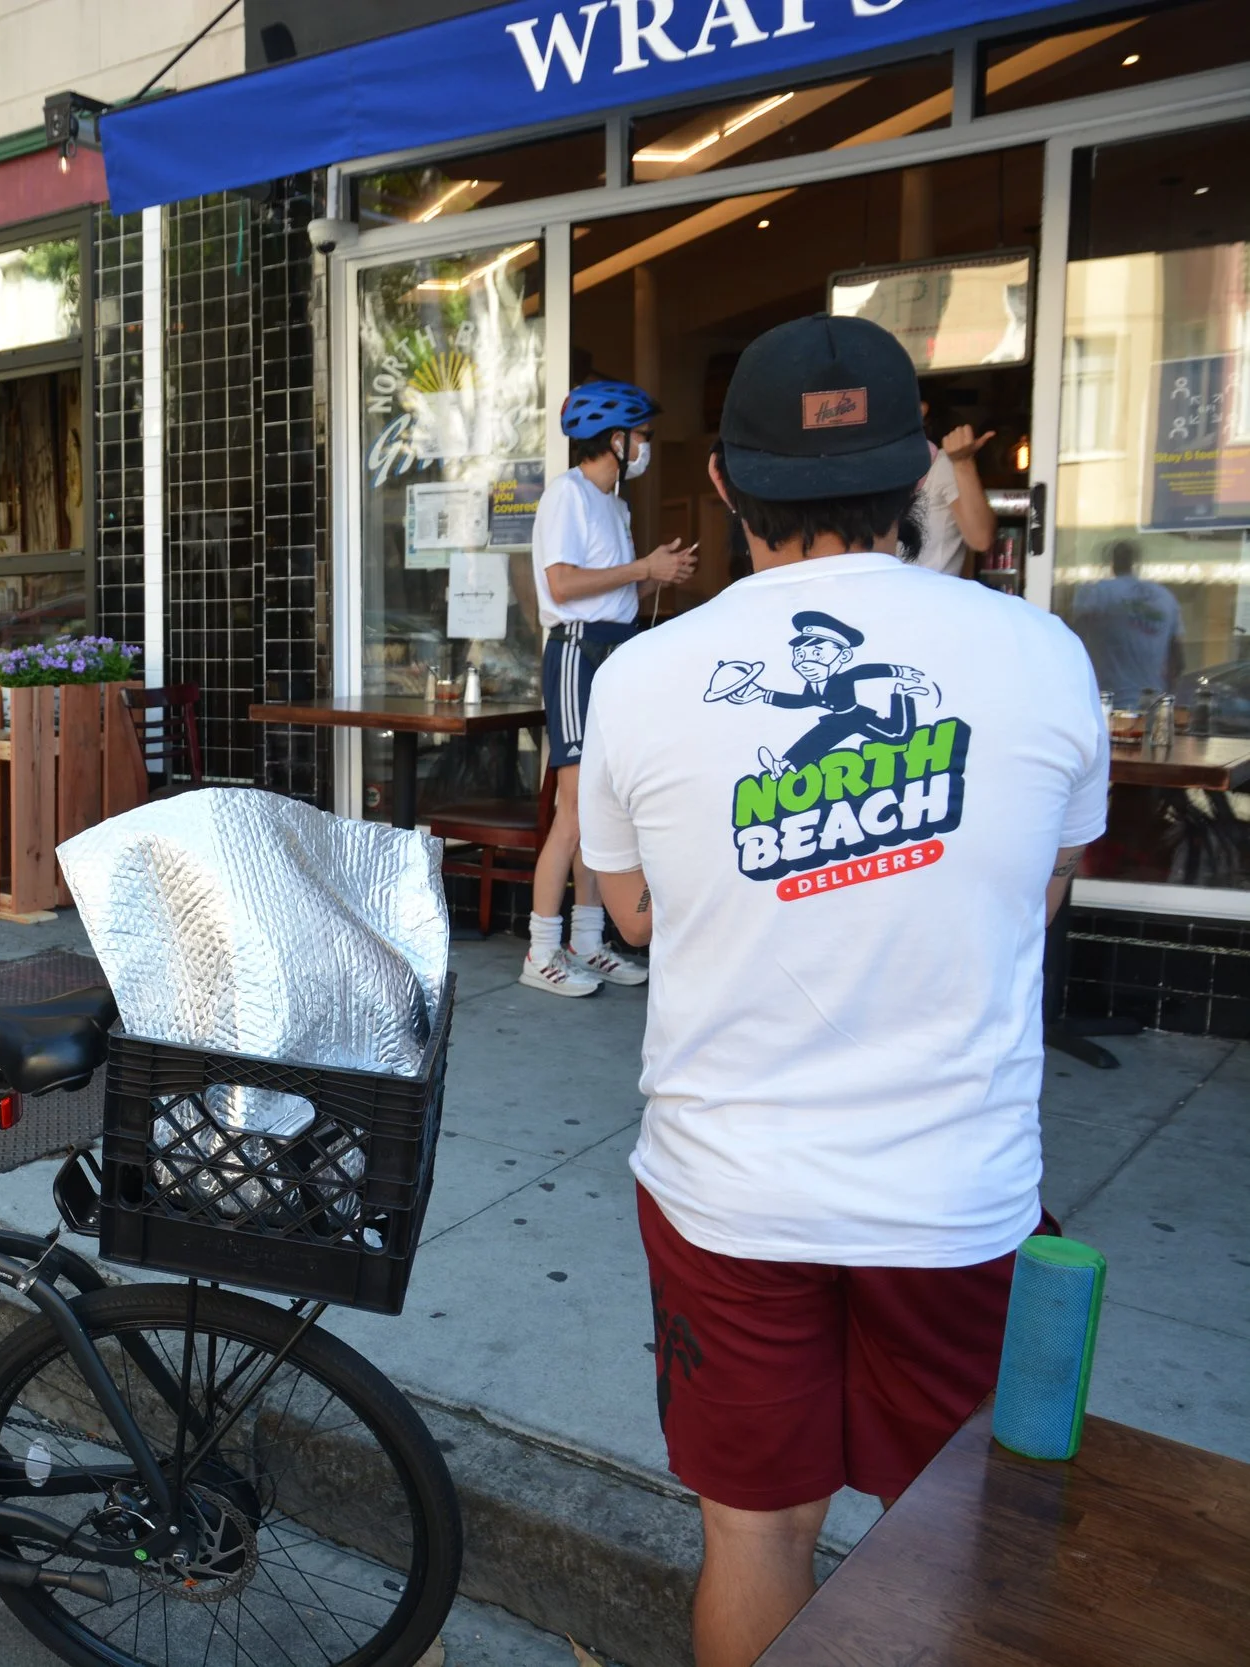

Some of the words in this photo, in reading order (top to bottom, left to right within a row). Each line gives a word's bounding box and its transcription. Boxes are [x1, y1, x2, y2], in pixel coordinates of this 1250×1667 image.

[505, 0, 905, 92] WRA
[368, 325, 436, 414] NORTH
[499, 479, 518, 491] got
[1154, 452, 1181, 464] Stay
[493, 493, 514, 505] you
[735, 721, 957, 827] NORTH
[738, 773, 950, 871] BEACH
[798, 849, 924, 893] DELIVERS
